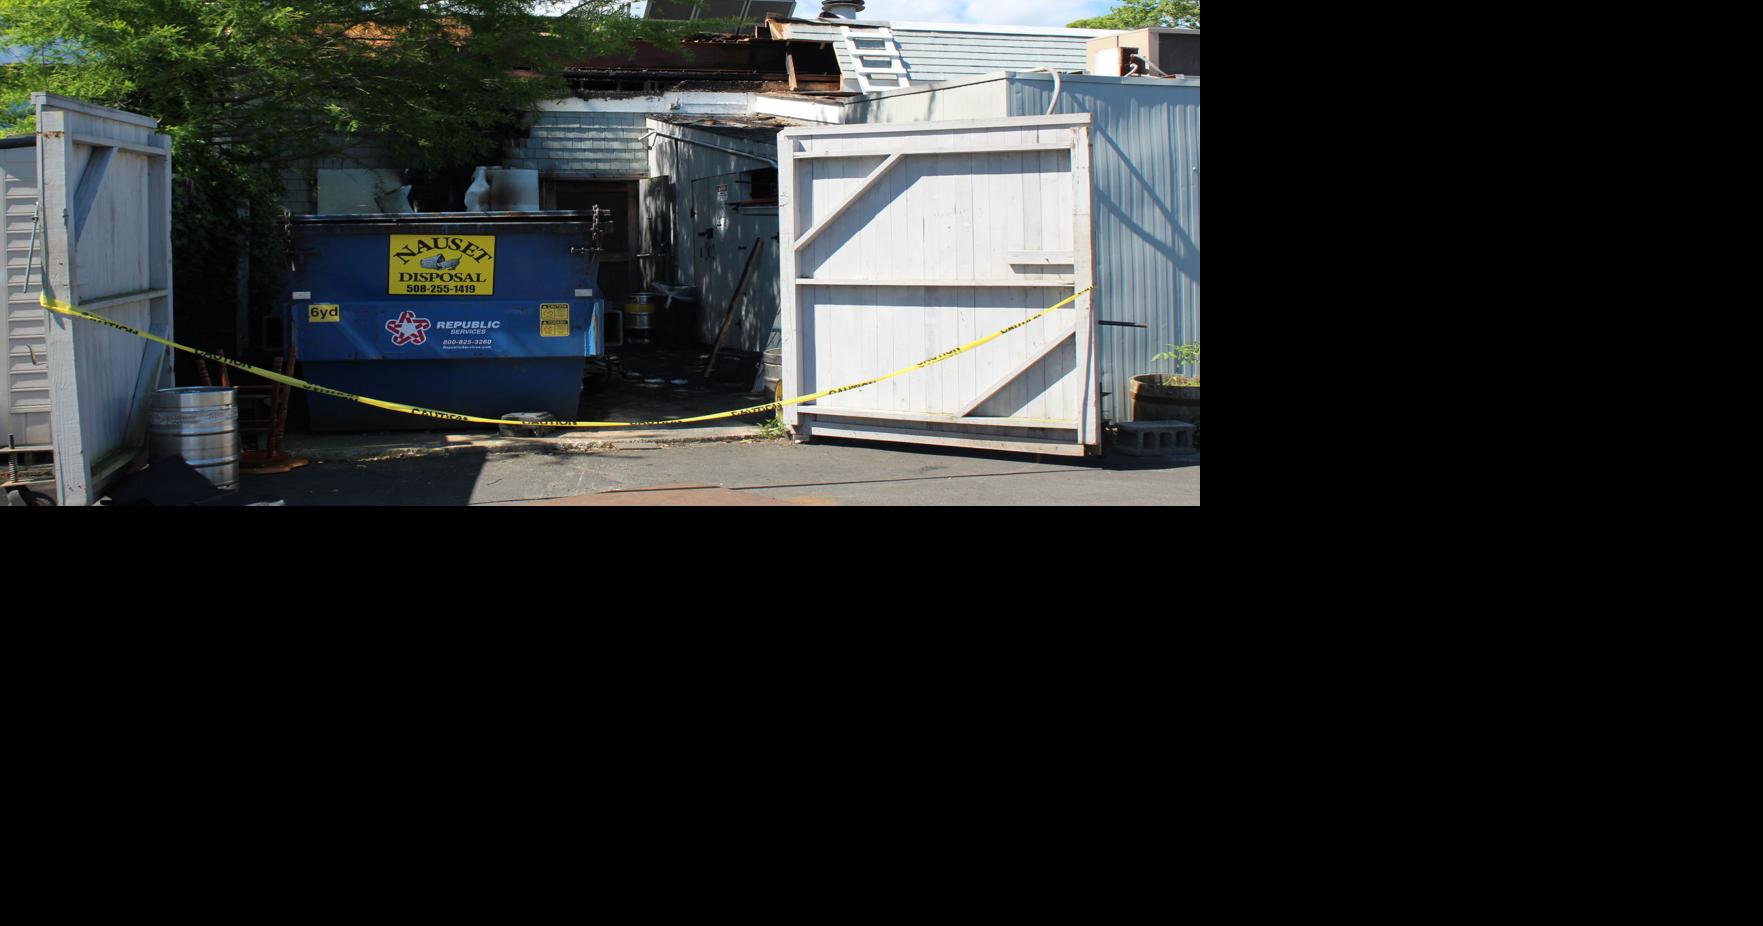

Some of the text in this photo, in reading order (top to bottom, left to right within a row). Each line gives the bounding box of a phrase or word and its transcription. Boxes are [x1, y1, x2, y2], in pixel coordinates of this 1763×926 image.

[393, 237, 492, 264] NAUSET
[398, 272, 487, 283] DISPOSAL
[406, 284, 476, 293] 508-255-1419
[310, 306, 338, 320] 6yd
[436, 320, 501, 329] REPUBLIC
